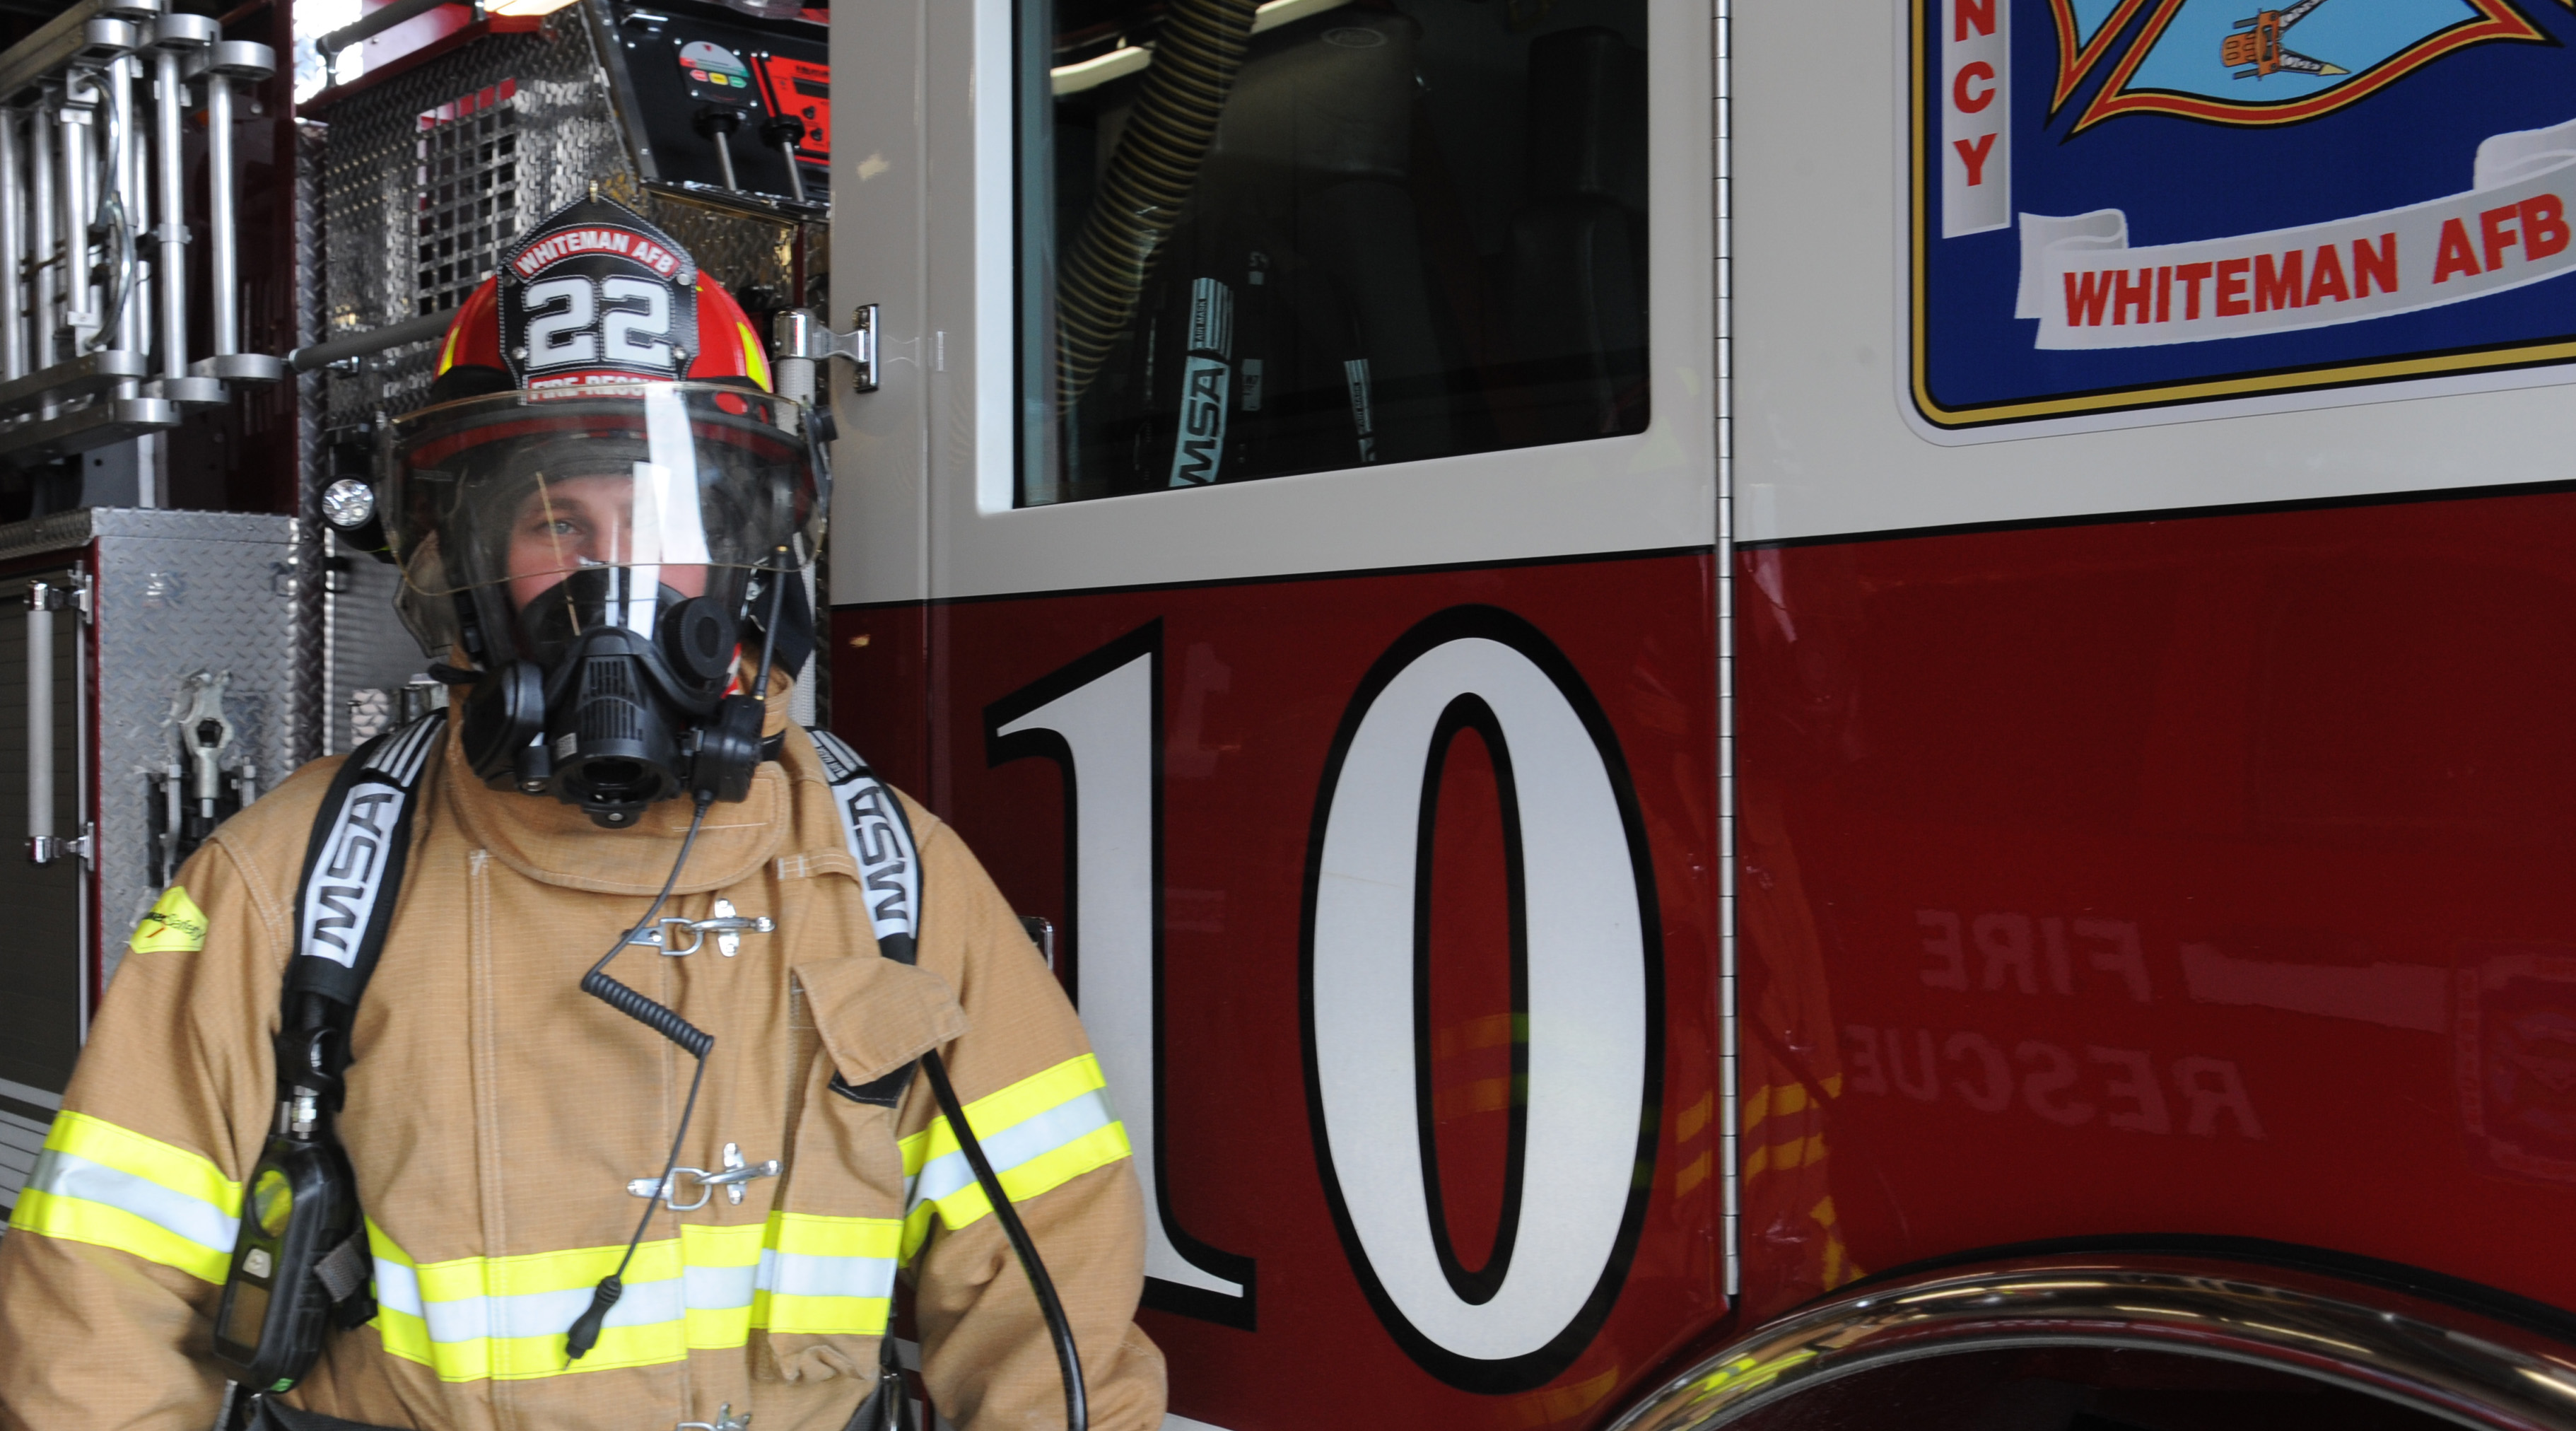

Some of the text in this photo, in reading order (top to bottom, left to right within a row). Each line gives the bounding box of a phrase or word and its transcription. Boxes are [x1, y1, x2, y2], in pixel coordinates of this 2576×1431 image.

[516, 230, 674, 277] WHITEMAN AFB
[2063, 193, 2571, 327] WHITEMAN AFB
[525, 278, 672, 368] 22
[531, 376, 579, 399] FIRE
[1178, 368, 1225, 484] MSA
[312, 793, 394, 952] MSA
[848, 786, 908, 921] MSA
[984, 603, 1665, 1394] 10
